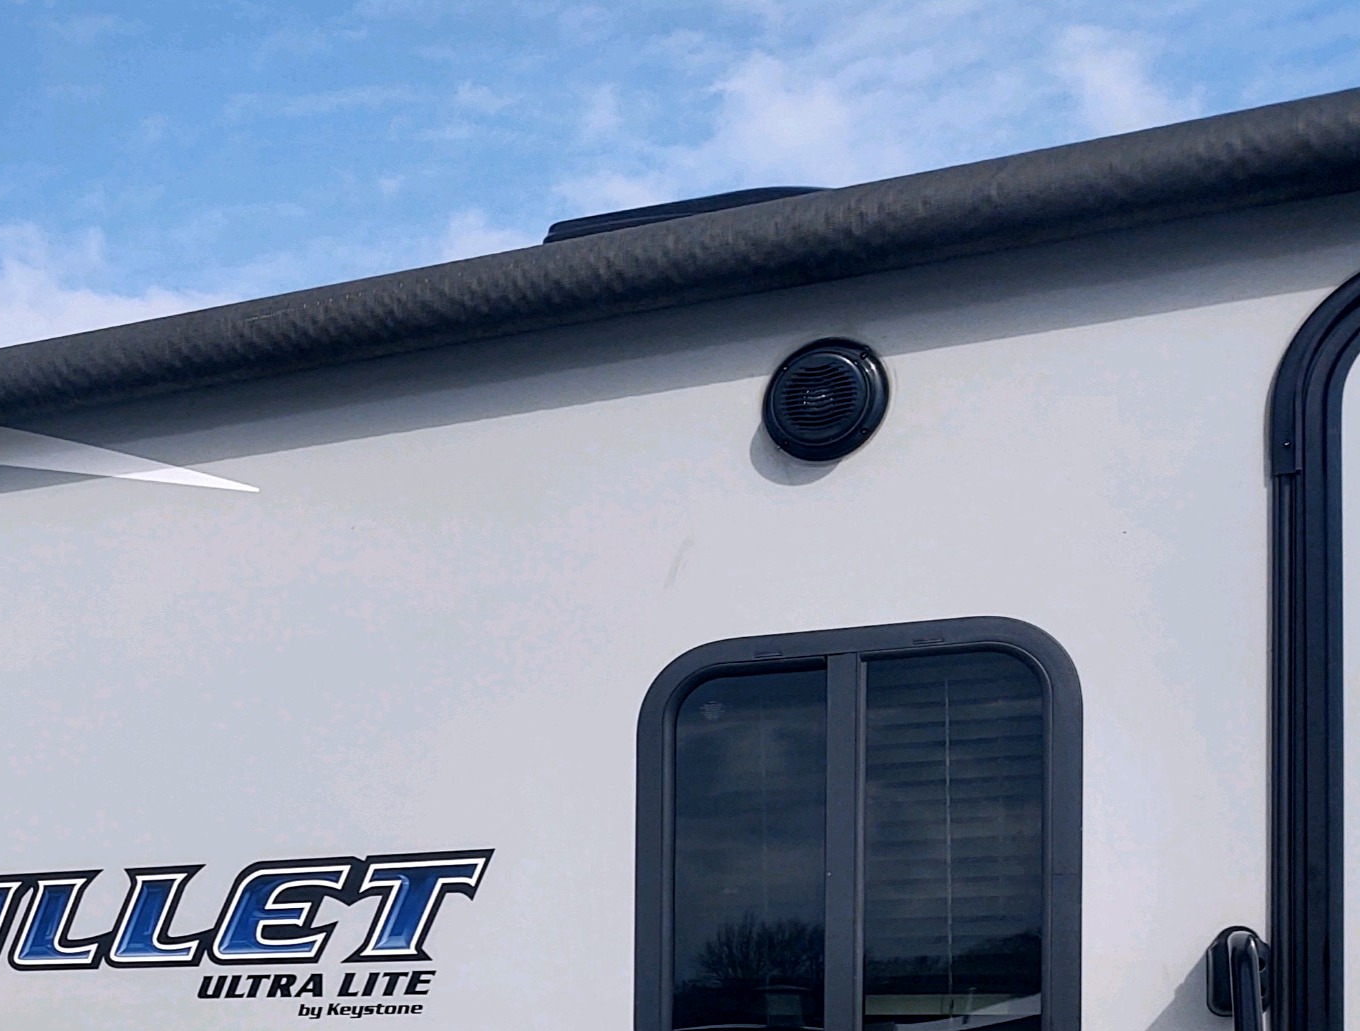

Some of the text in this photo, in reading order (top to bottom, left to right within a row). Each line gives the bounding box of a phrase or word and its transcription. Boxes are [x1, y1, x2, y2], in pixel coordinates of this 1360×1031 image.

[197, 970, 437, 999] ULTRA LITE
[298, 1003, 423, 1019] by Keystone
